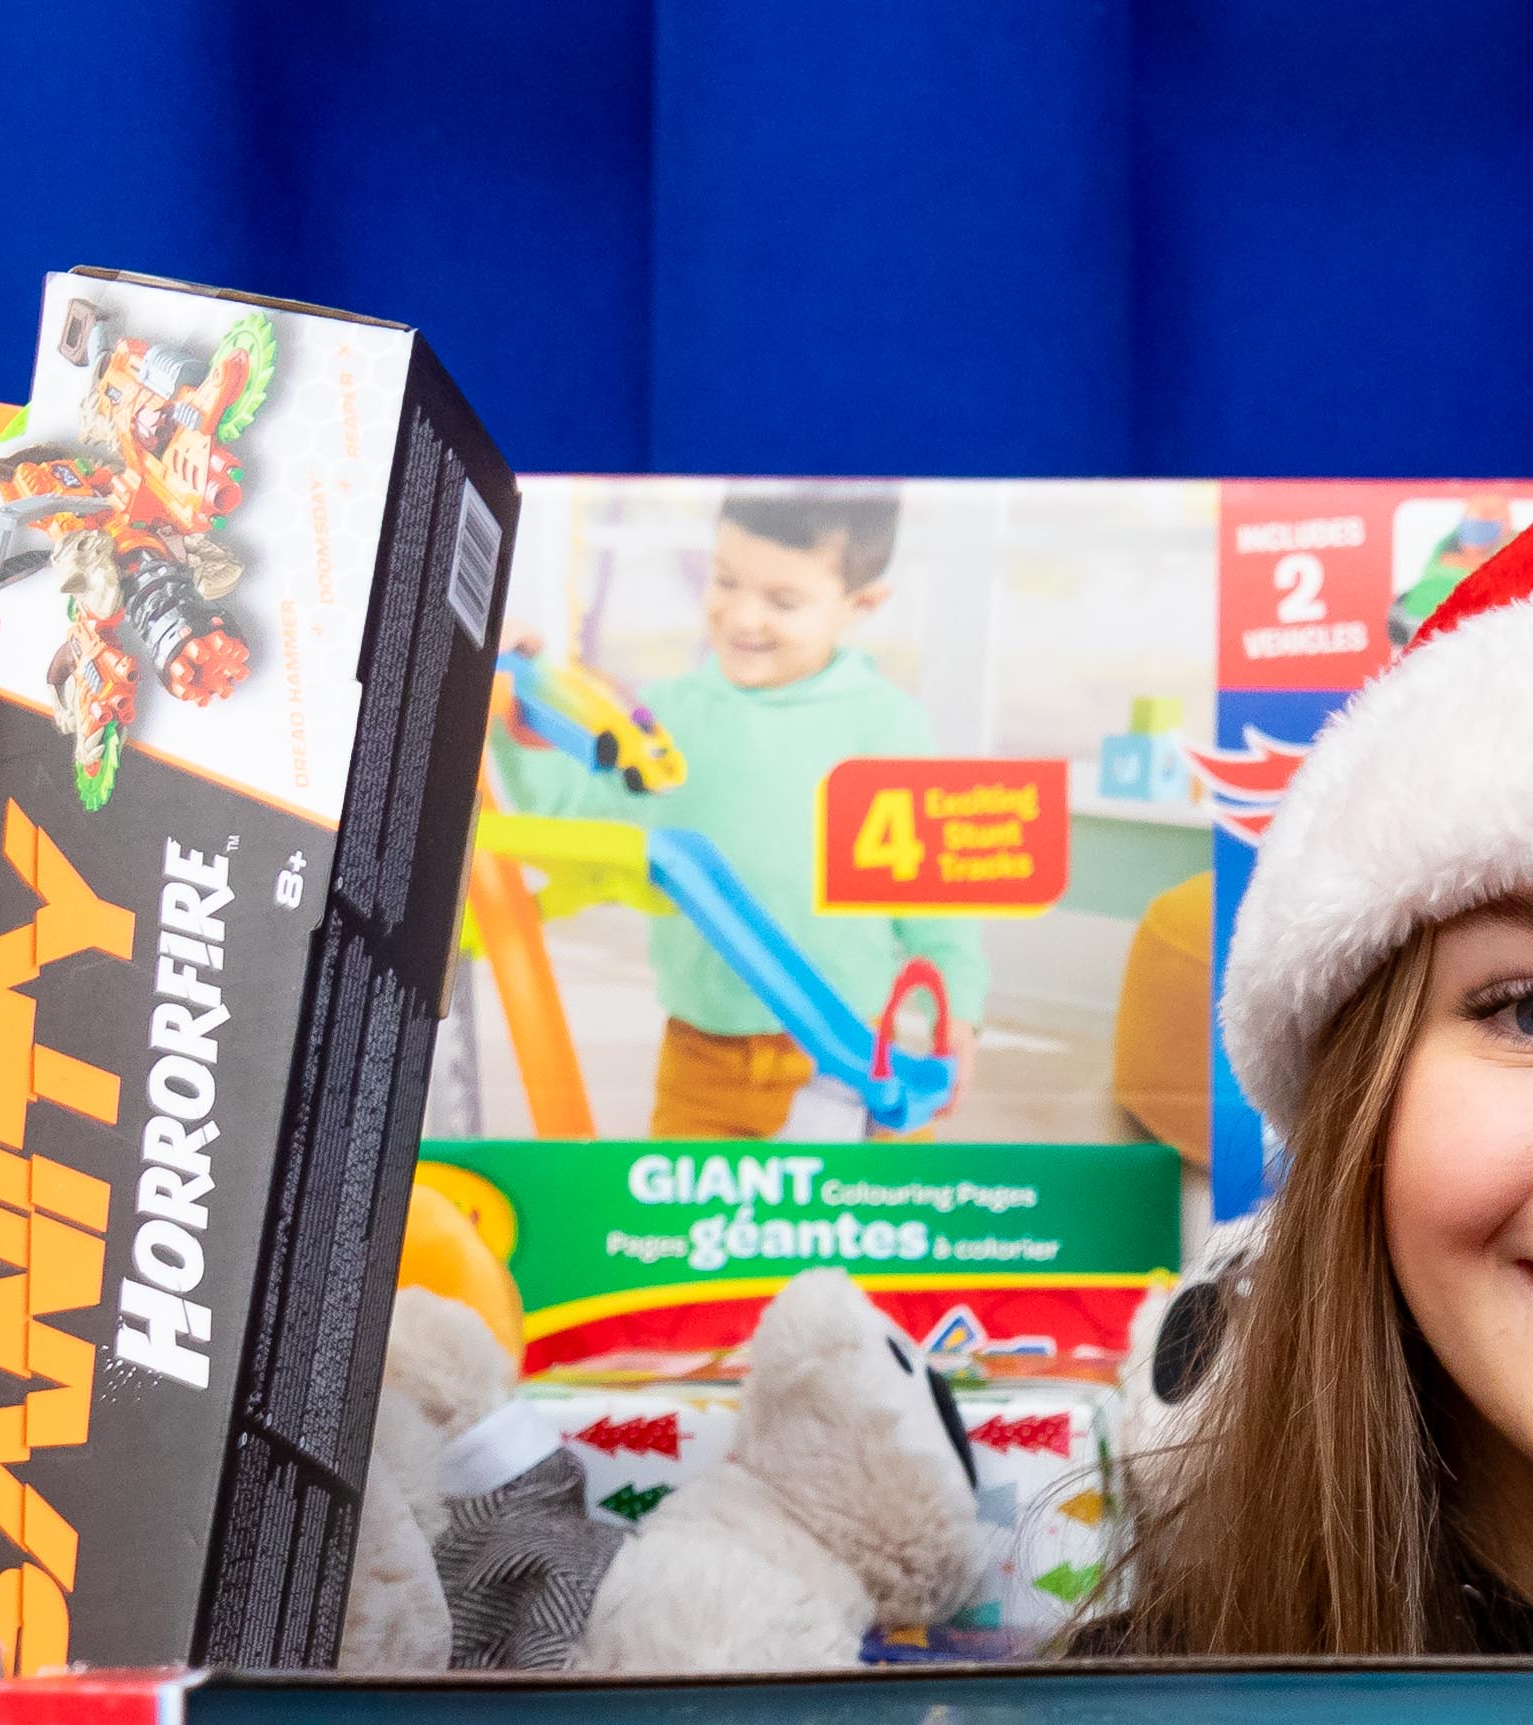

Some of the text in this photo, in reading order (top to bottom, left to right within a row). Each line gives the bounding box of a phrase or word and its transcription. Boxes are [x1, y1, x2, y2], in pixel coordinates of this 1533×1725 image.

[338, 373, 361, 460] REAPER
[1236, 515, 1366, 555] INCLUDES
[1274, 553, 1327, 624] 2
[1243, 620, 1369, 660] VEHICLES
[278, 598, 310, 789] DREAD HAMMER
[853, 783, 1040, 882] 4 Exciting
[942, 820, 1023, 849] Stunt
[276, 849, 309, 909] 8+
[937, 850, 1034, 882] Tracks
[628, 1155, 1037, 1213] GIANT Colouring Pages
[606, 1231, 688, 1263] Pages
[689, 1205, 928, 1271] géantes
[952, 1237, 1061, 1261] colorier
